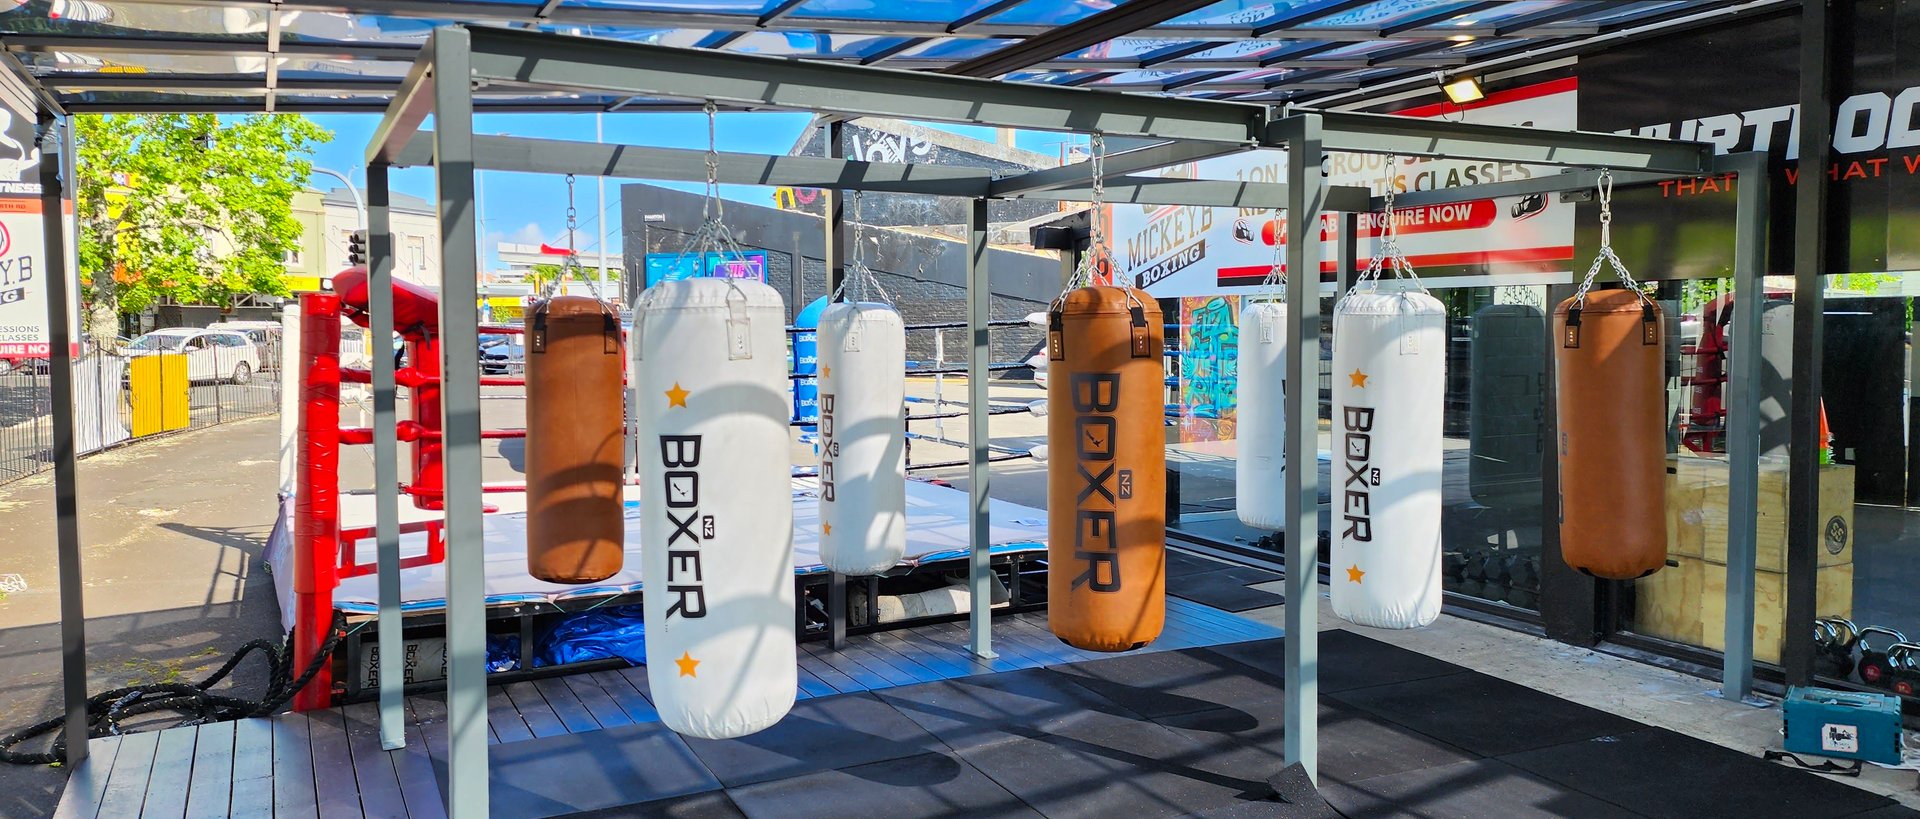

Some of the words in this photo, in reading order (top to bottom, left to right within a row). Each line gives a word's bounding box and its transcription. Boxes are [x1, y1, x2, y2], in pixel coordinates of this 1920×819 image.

[1321, 153, 1387, 178] GROU
[1657, 173, 1738, 198] THAT
[1429, 203, 1473, 225] NOW
[1127, 206, 1213, 273] MICKEY.B
[1141, 243, 1200, 289] BOXING
[28, 344, 49, 354] NO
[821, 393, 836, 502] BOXER
[1069, 372, 1121, 593] BOXER
[1120, 472, 1131, 497] NZ
[1342, 405, 1375, 543] BOXER
[1371, 469, 1380, 485] NZ
[659, 435, 707, 620] BOXER
[703, 516, 714, 538] NZ
